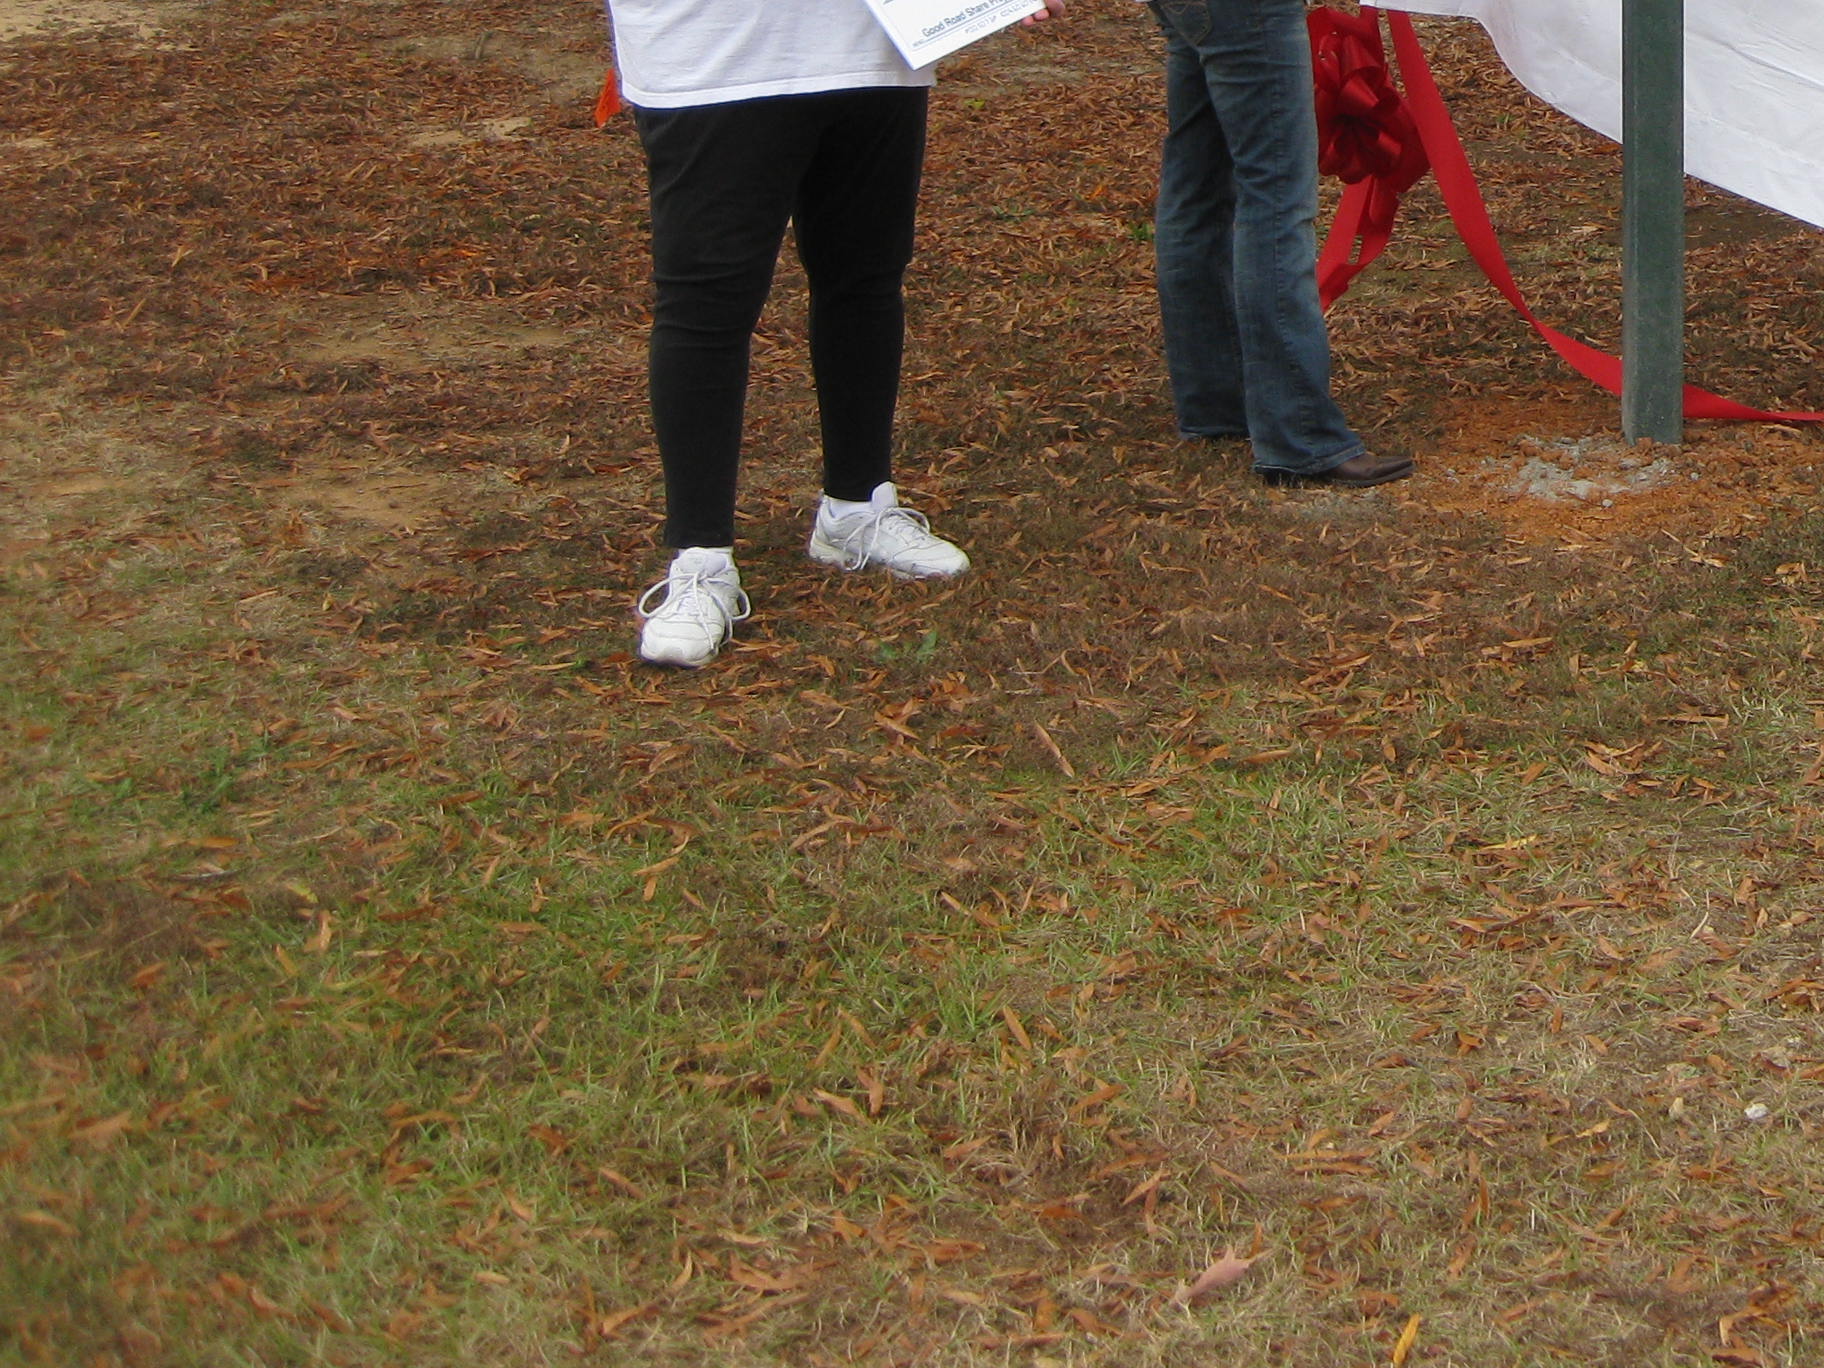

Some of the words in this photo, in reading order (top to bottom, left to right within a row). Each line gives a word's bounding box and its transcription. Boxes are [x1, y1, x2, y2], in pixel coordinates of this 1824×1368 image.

[921, 21, 945, 37] Good
[944, 11, 966, 28] Road
[965, 1, 989, 16] Share
